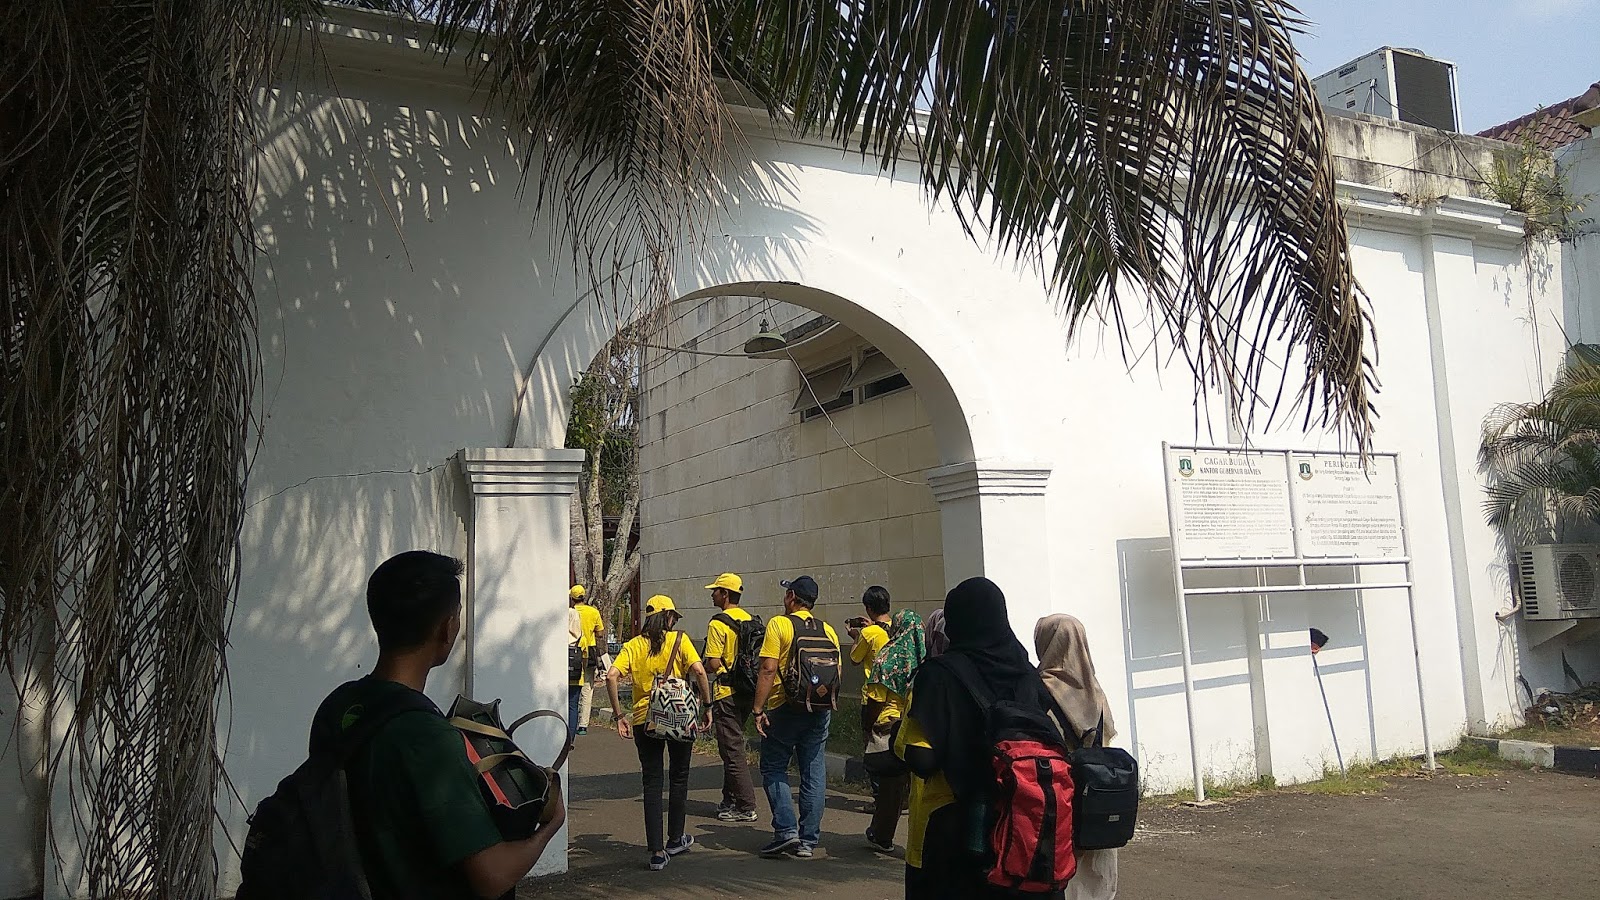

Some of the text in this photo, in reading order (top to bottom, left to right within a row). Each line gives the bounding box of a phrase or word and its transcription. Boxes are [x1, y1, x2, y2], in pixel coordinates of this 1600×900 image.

[1203, 457, 1229, 466] CAGAR
[1324, 460, 1367, 469] PERINGAT
[1199, 467, 1218, 475] KANTOR
[1219, 467, 1243, 475] GUBERNUR
